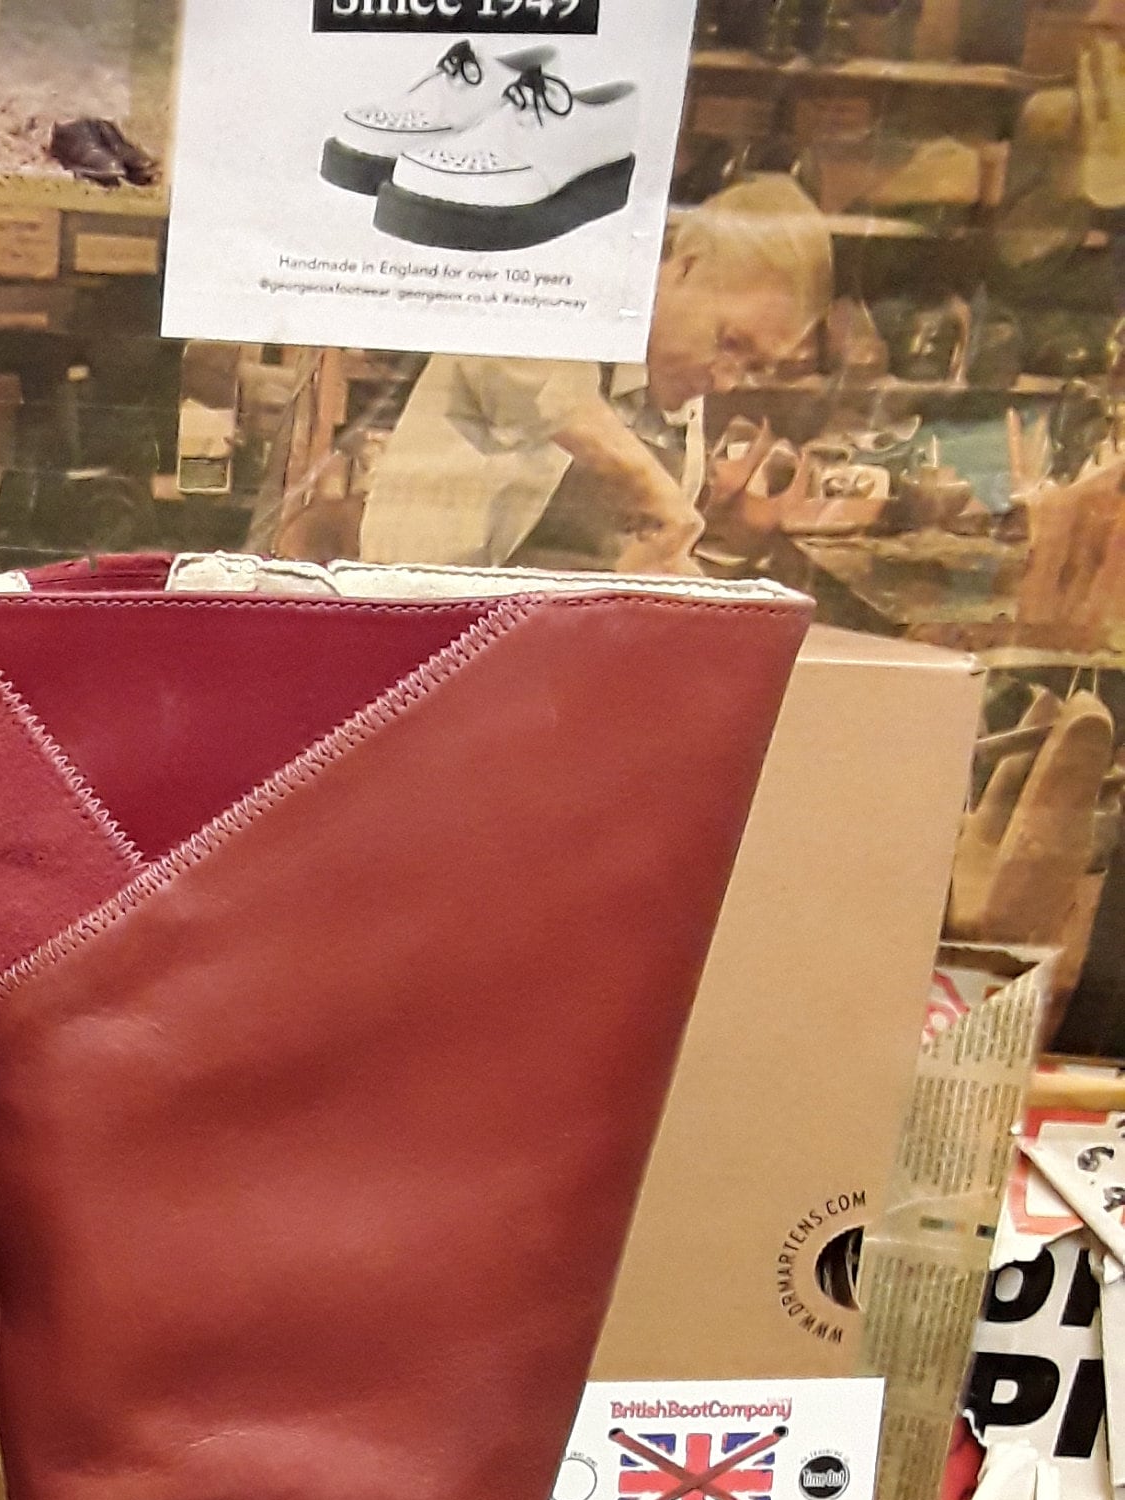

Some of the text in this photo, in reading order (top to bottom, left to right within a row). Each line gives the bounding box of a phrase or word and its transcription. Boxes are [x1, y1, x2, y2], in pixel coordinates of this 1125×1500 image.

[278, 254, 572, 289] Handmade in England for over 100 years
[611, 1397, 793, 1422] BritishBootCompany
